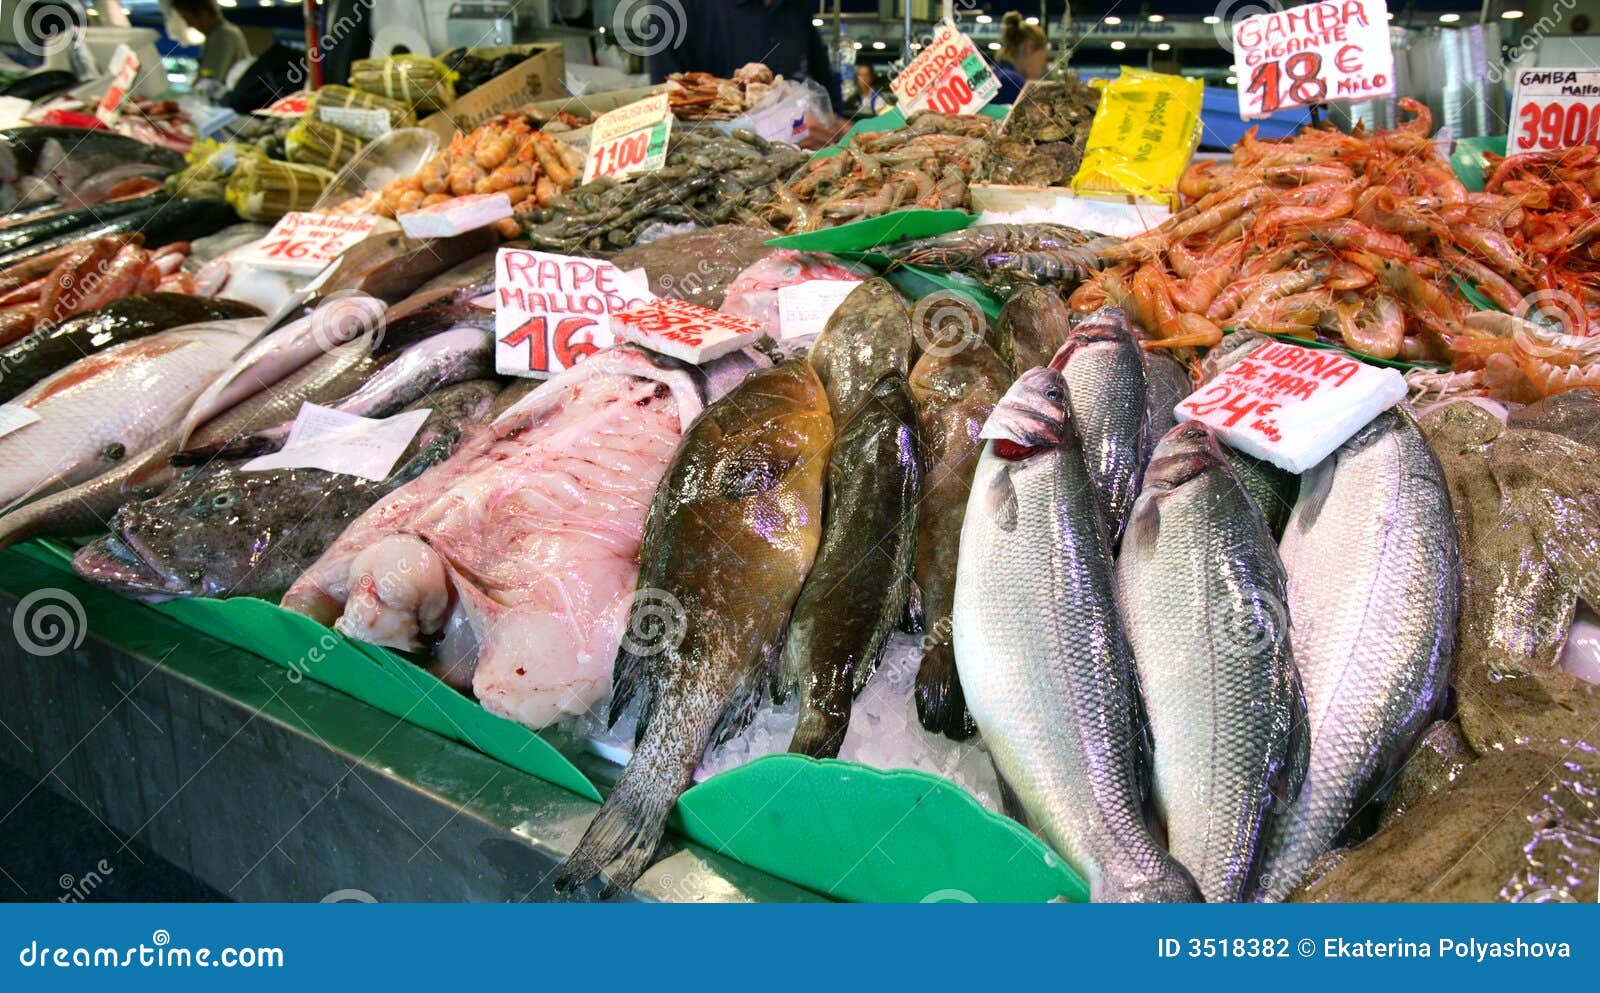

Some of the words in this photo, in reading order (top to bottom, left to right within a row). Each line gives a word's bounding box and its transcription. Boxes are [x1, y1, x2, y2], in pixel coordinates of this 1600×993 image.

[1237, 0, 1369, 48] GAMBA
[1245, 26, 1348, 66] GIGANTE
[904, 44, 959, 97] GORDO
[1247, 51, 1328, 112] 18
[1335, 44, 1364, 73] €
[1520, 71, 1577, 86] GAMBA
[259, 239, 316, 258] 16
[504, 251, 619, 293] RAPE
[499, 315, 600, 371] 16
[1183, 386, 1260, 427] 24
